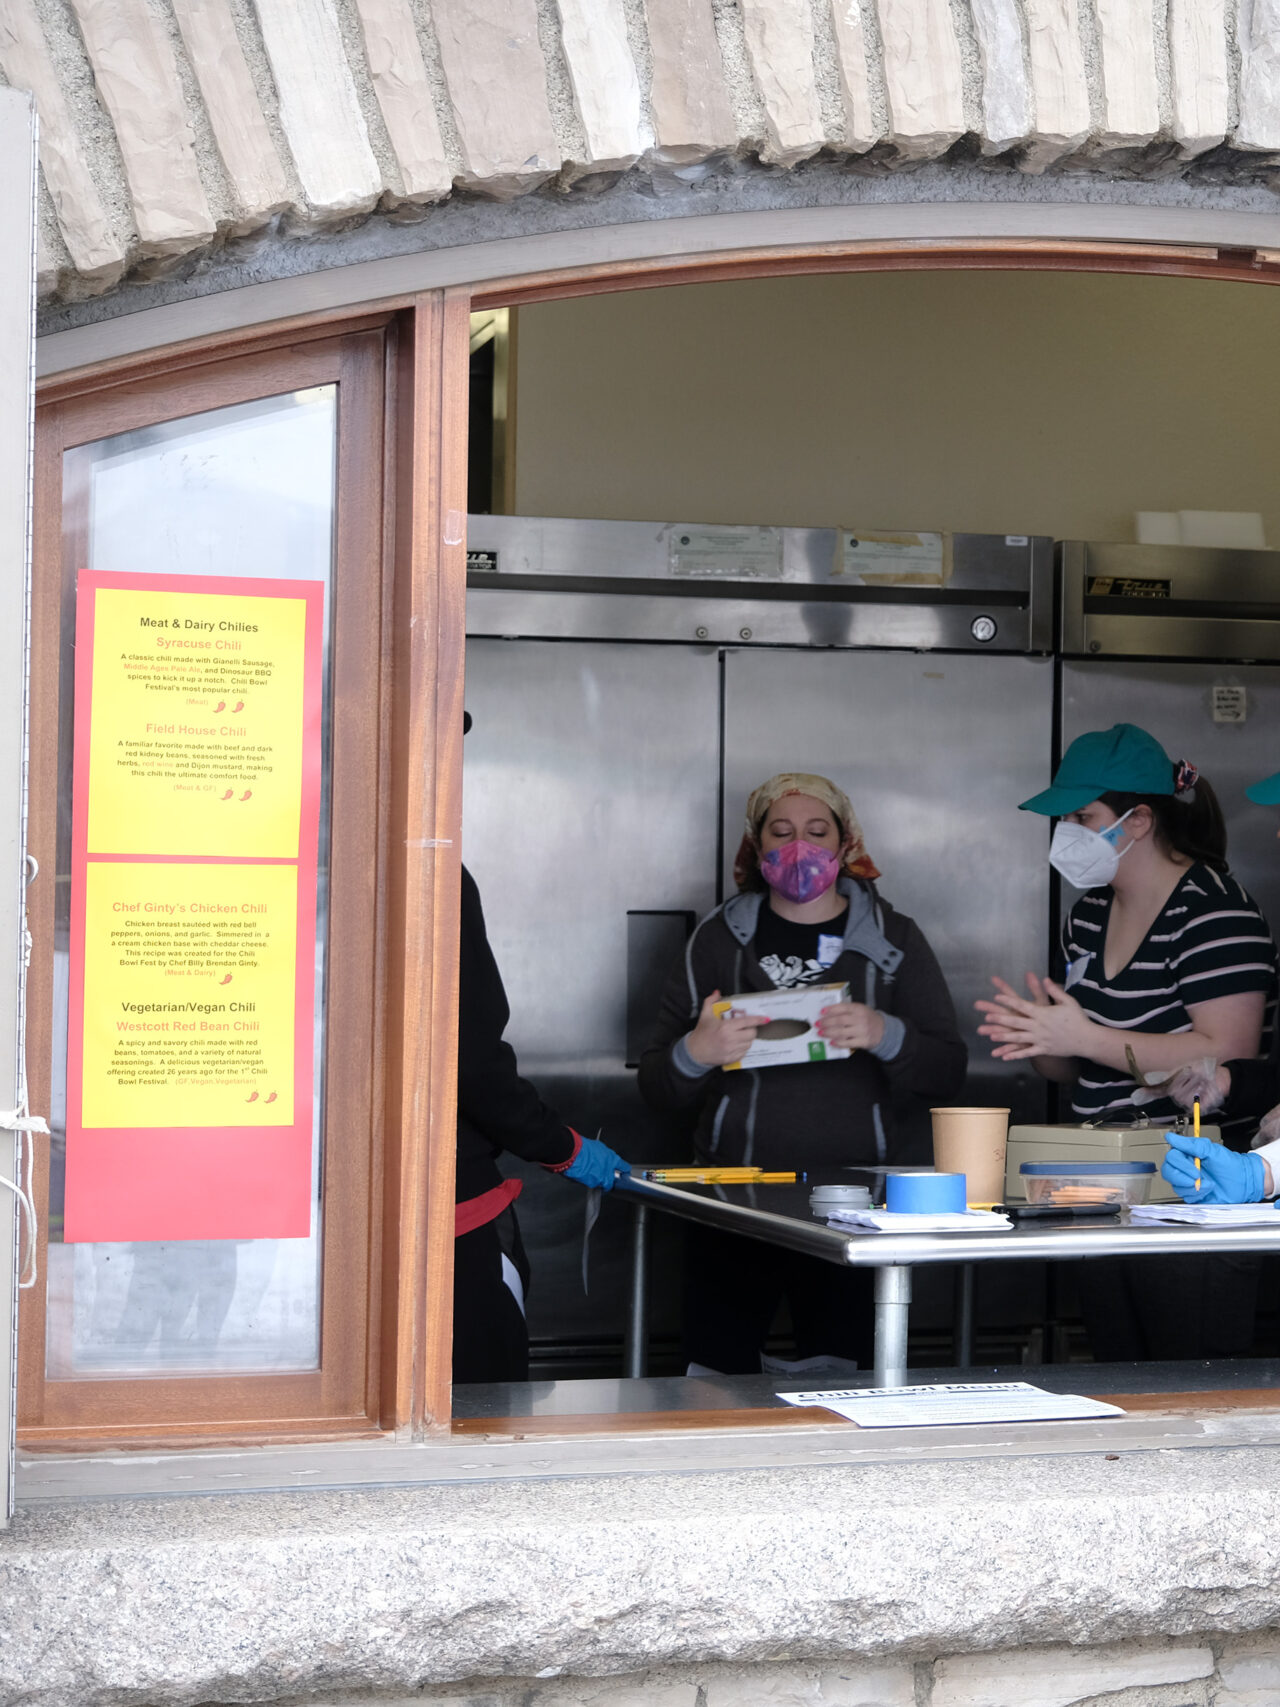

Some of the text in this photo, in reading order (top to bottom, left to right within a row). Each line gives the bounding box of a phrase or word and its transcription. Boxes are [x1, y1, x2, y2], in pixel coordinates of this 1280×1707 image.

[140, 617, 258, 633] Meat & Dairy Chilies
[156, 637, 241, 652] Syracuse Chili
[146, 723, 246, 737] Field House Chili
[112, 902, 267, 915] Chef Ginty's Chicken Chili
[122, 1002, 255, 1015] Vegetarian/Vegan Chili
[116, 1021, 259, 1032] Westcott Red Bean Chili
[798, 1389, 858, 1398] Chili
[945, 1383, 1019, 1391] Menu
